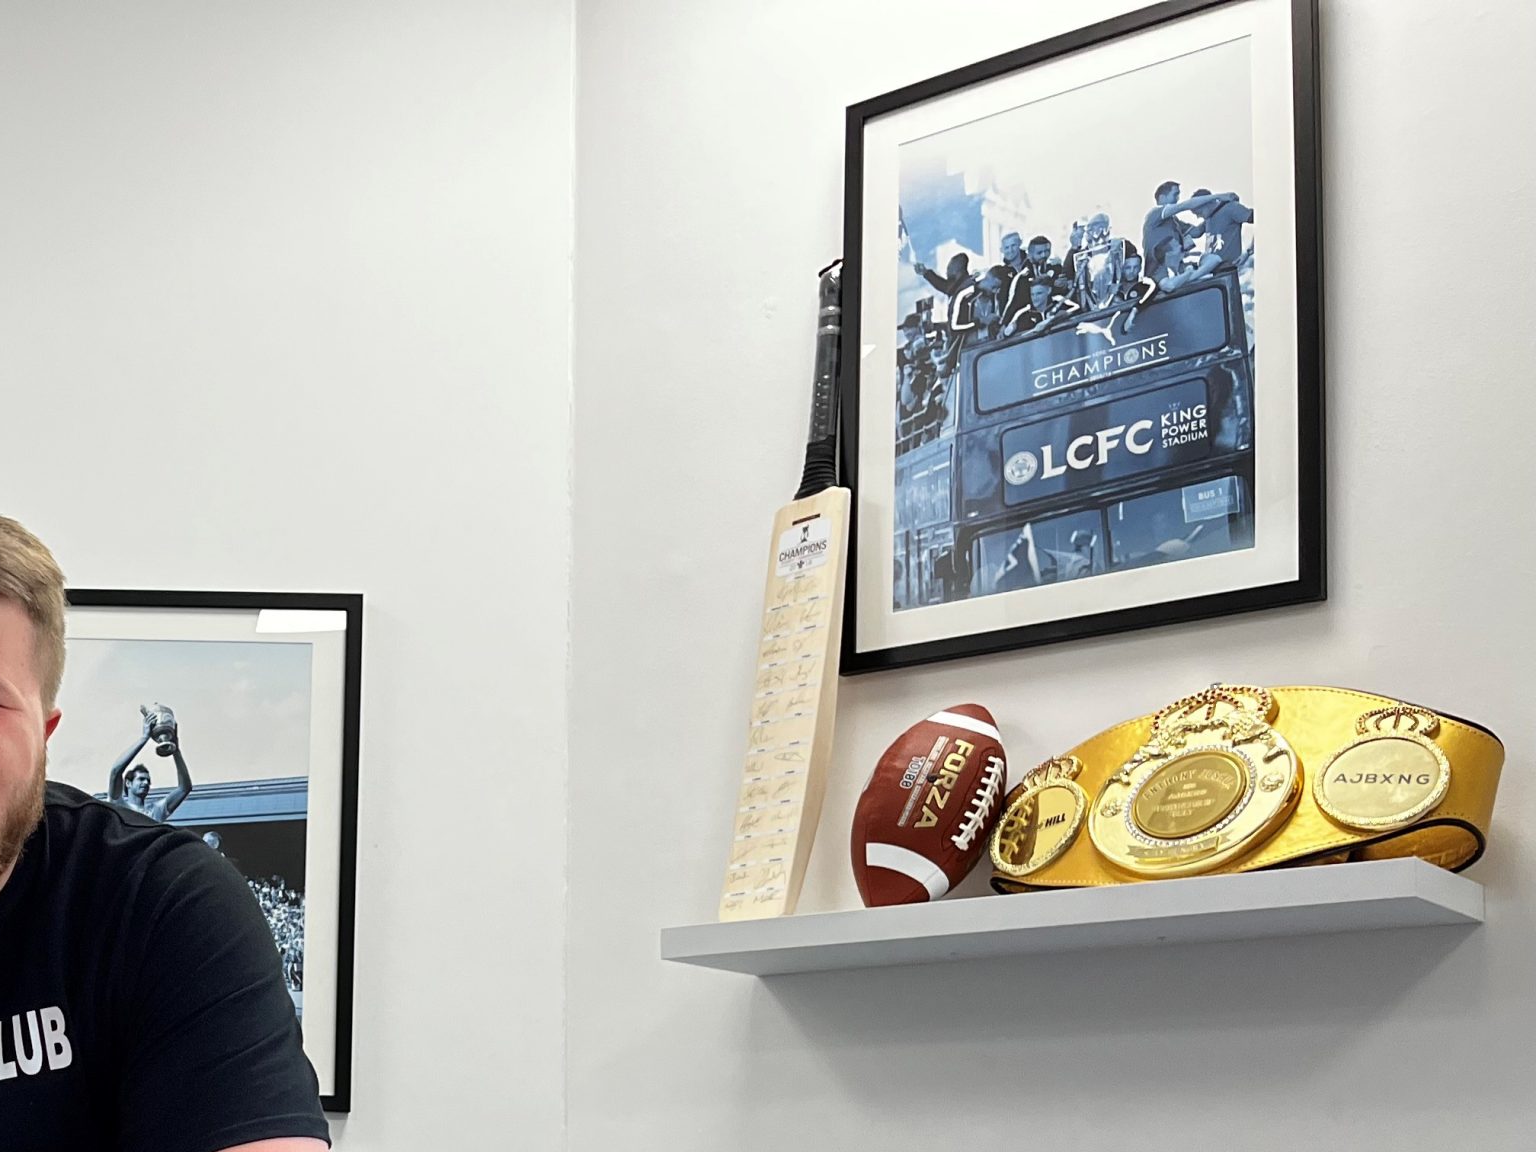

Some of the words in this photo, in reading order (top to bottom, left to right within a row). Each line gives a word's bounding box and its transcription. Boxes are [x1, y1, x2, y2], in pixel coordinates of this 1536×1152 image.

[1161, 404, 1207, 426] KING
[1162, 417, 1207, 438] POWER
[1162, 429, 1208, 448] STADIUM
[1041, 421, 1154, 478] LCFC
[1198, 490, 1215, 500] BUS
[779, 540, 827, 562] CHAMPIONS
[914, 739, 975, 828] FORZA
[1332, 770, 1431, 786] AJBXNG
[1045, 813, 1065, 827] HILL
